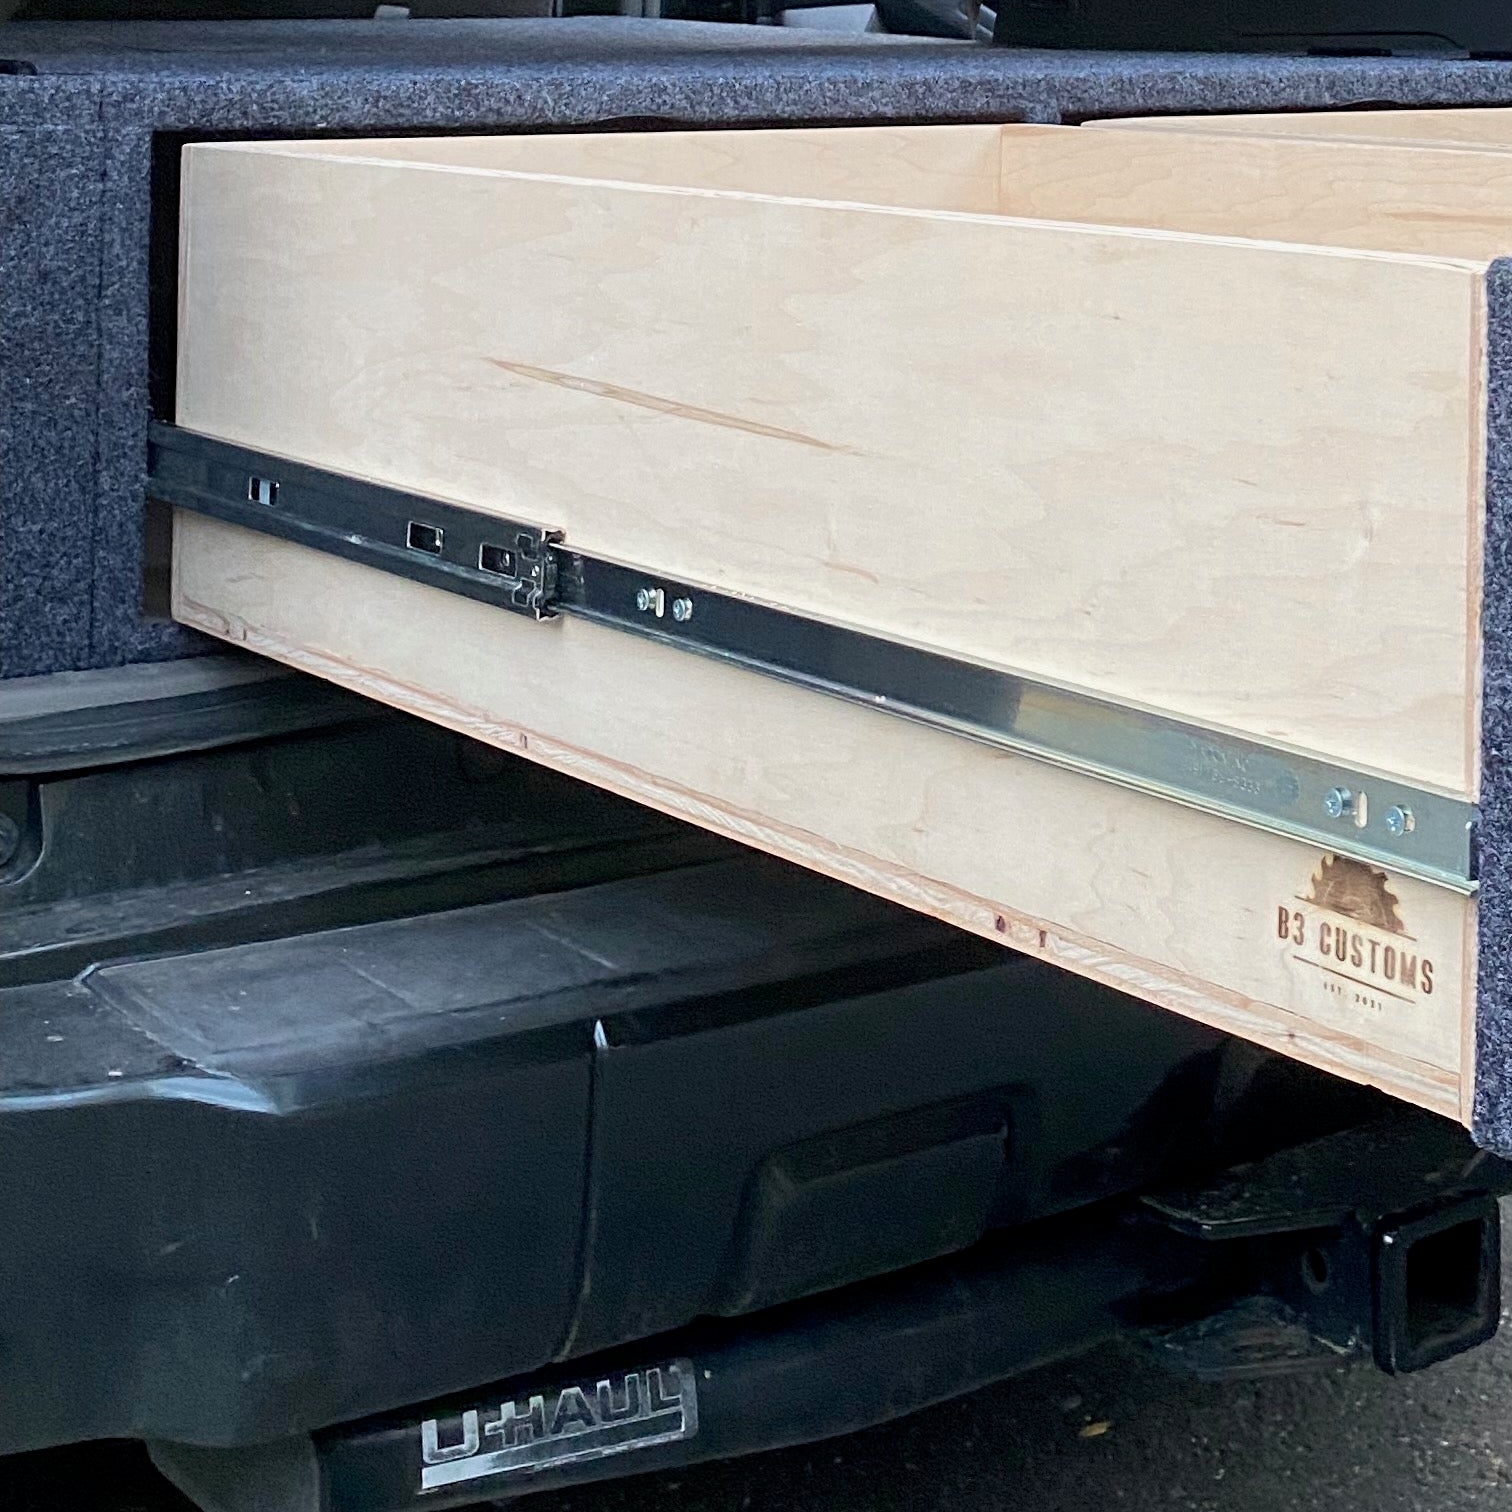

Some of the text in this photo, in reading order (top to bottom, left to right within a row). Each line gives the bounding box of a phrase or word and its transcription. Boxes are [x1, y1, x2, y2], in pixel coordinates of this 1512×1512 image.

[1277, 905, 1434, 995] B3 CUSTOMS
[421, 1367, 683, 1464] U-HAUL
